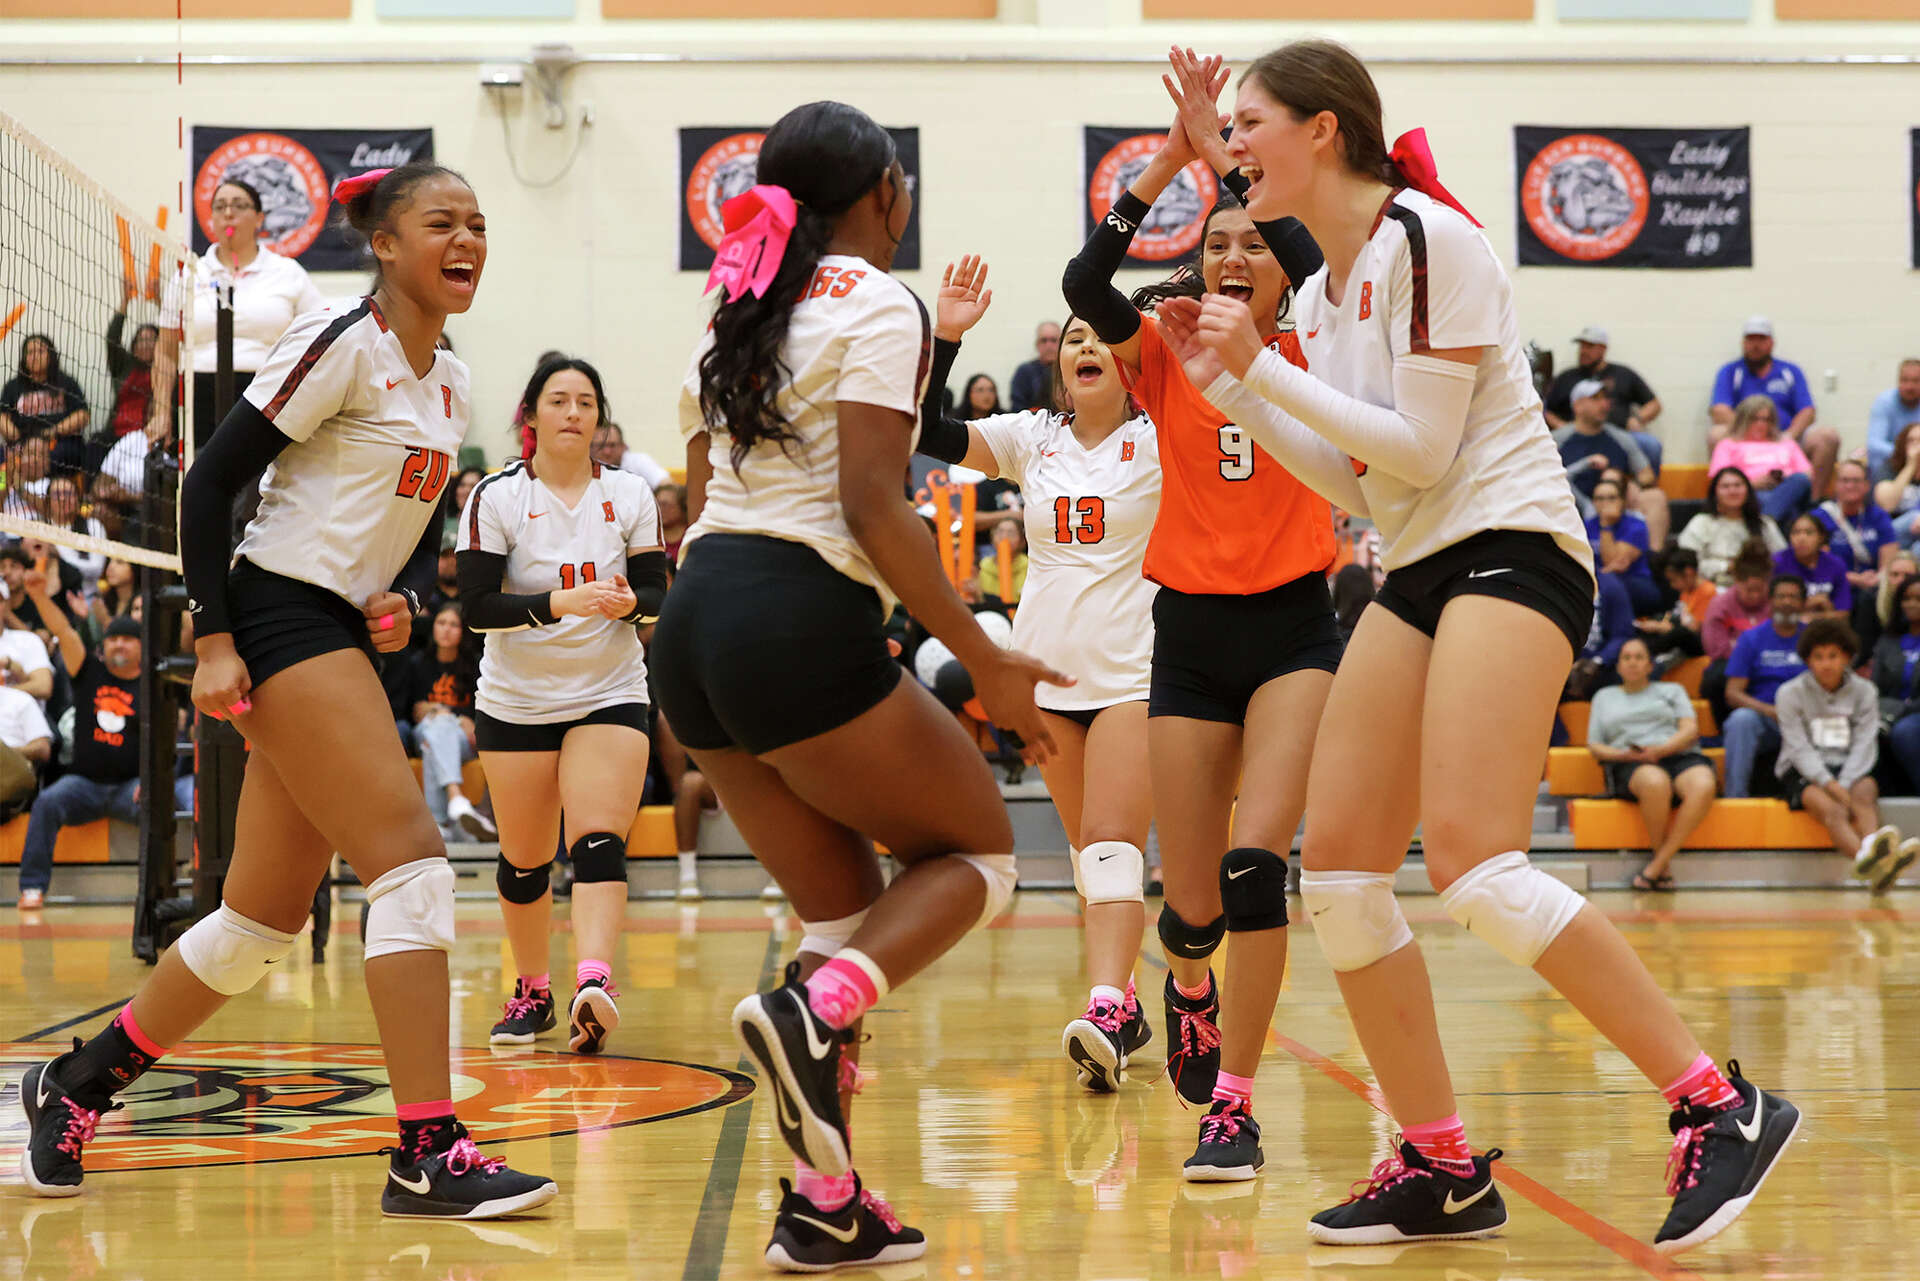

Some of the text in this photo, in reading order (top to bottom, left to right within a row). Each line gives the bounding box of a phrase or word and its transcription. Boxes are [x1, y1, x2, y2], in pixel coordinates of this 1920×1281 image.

[350, 142, 412, 169] Lady
[1669, 140, 1730, 170] Lady
[1651, 169, 1748, 200] Bulldogs
[1686, 232, 1720, 256] #9
[1359, 280, 1372, 321] B
[440, 383, 452, 419] B
[1120, 440, 1135, 462] B
[1218, 423, 1255, 481] 9
[395, 444, 450, 503] 20
[1054, 495, 1105, 544] 13
[559, 561, 597, 590] 11
